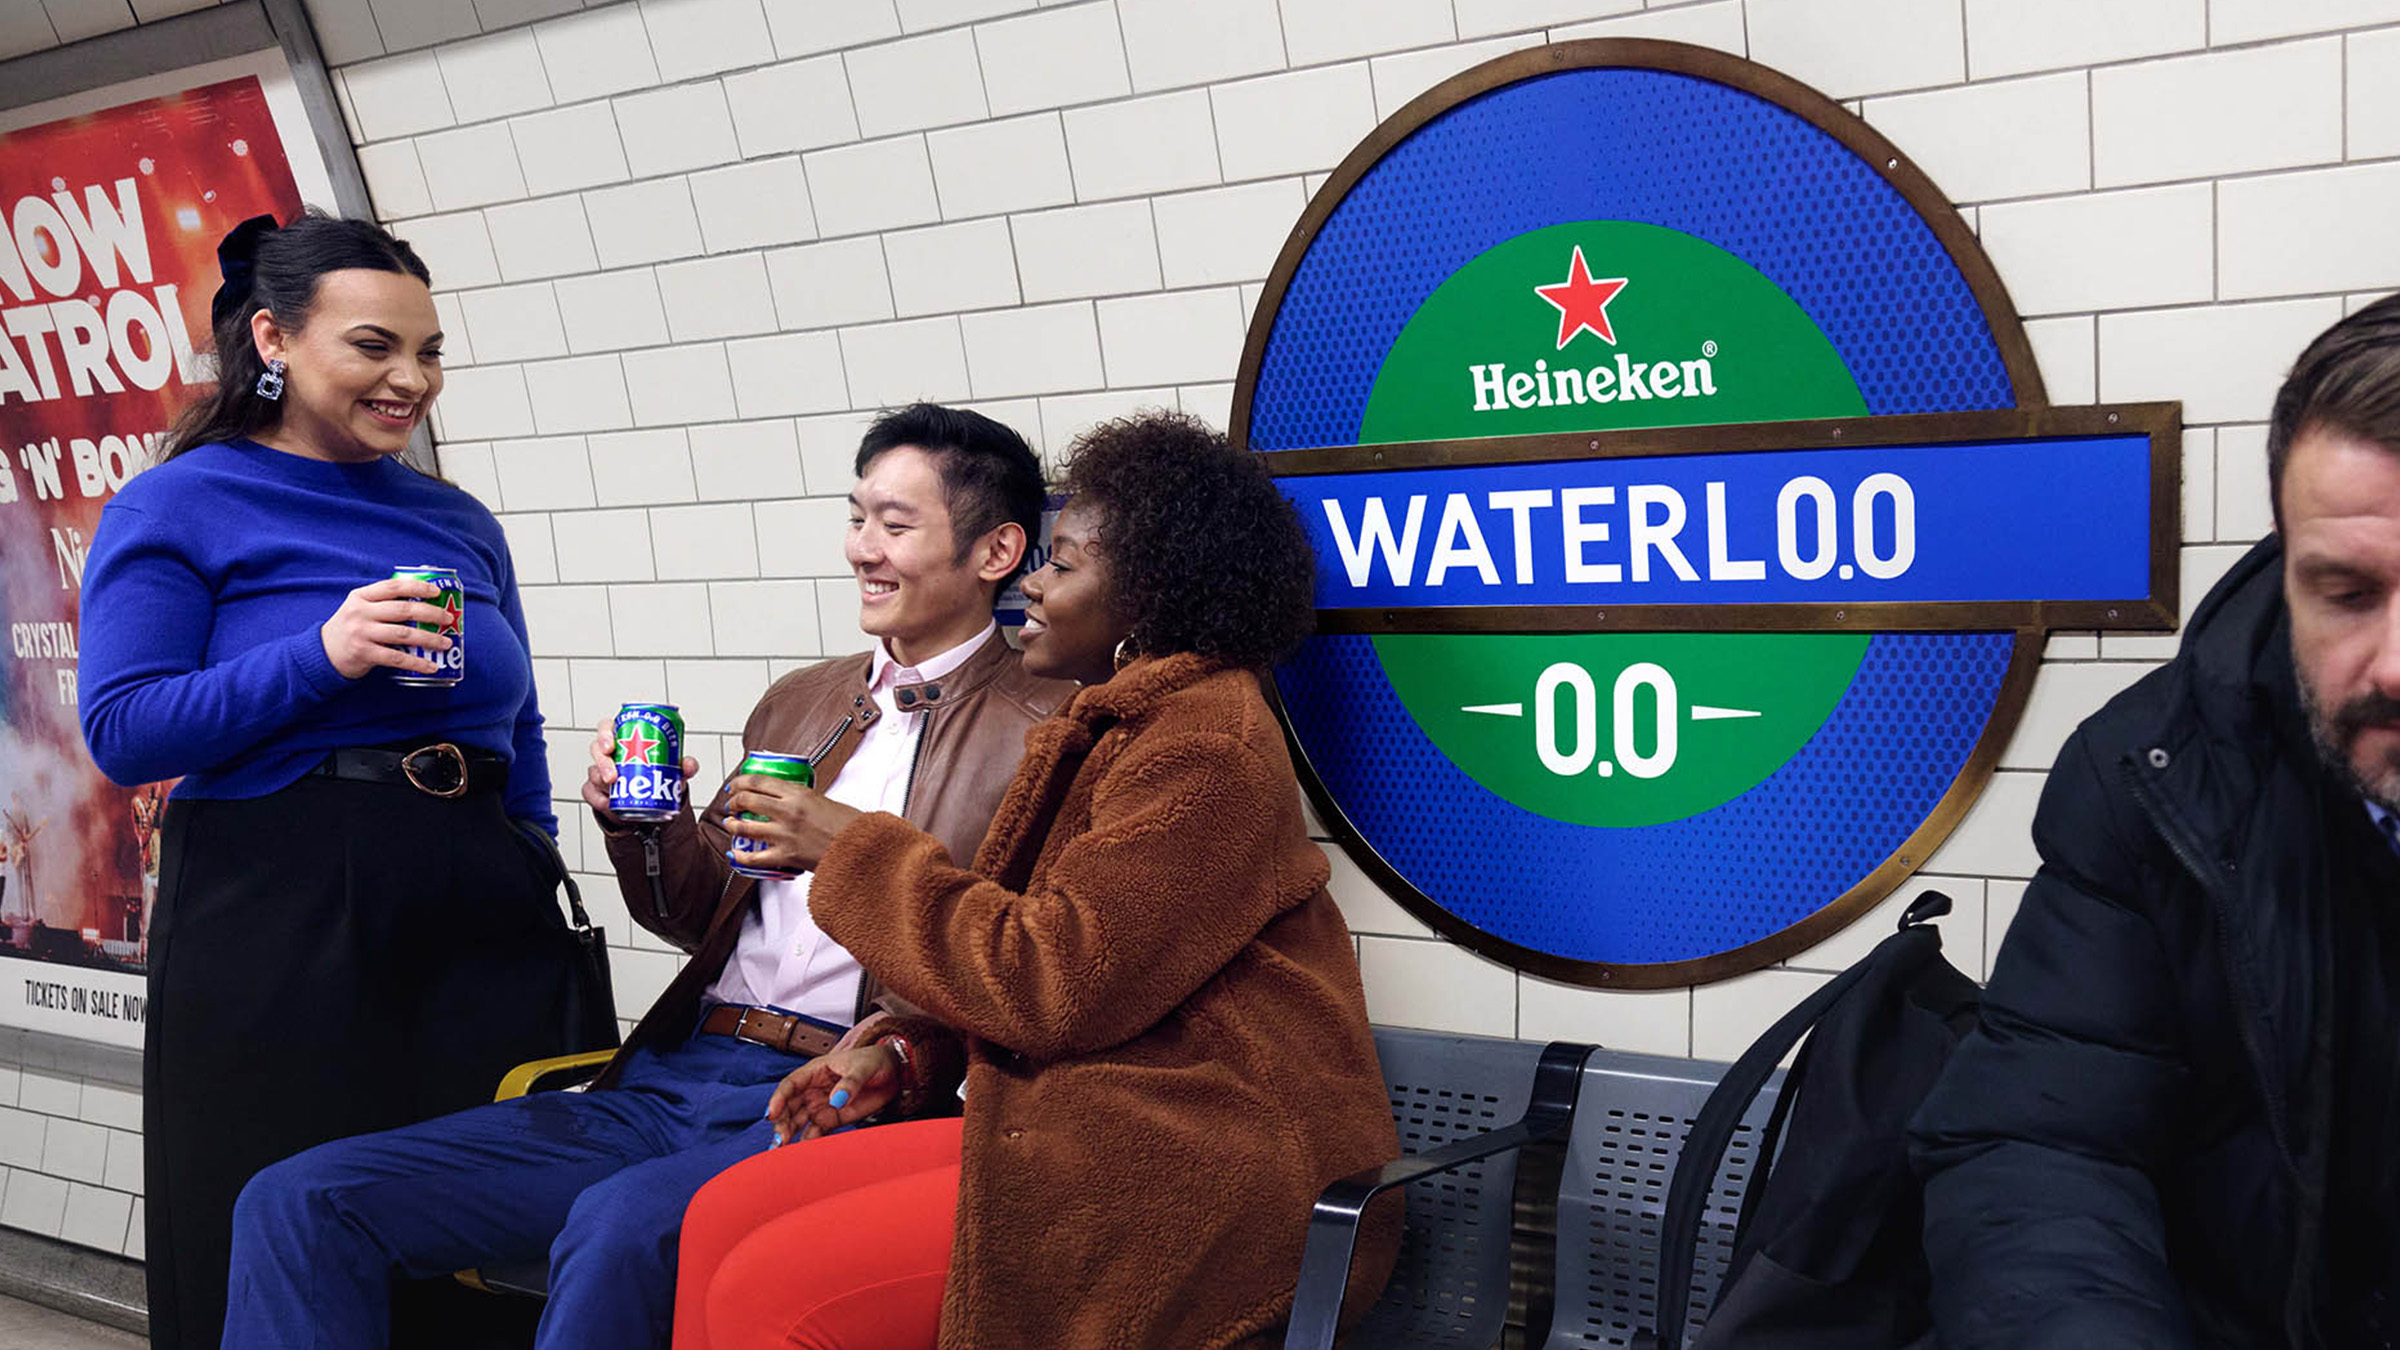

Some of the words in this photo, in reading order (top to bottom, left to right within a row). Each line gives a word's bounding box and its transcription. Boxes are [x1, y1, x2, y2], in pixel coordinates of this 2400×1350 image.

[1470, 354, 1718, 412] Heineken
[70, 431, 171, 498] BON
[50, 527, 91, 590] Ni
[12, 621, 79, 660] CRYSTAL
[1535, 662, 1678, 779] 0.0
[25, 979, 68, 1011] TICKETS
[71, 987, 87, 1014] ON
[91, 989, 119, 1019] SALE
